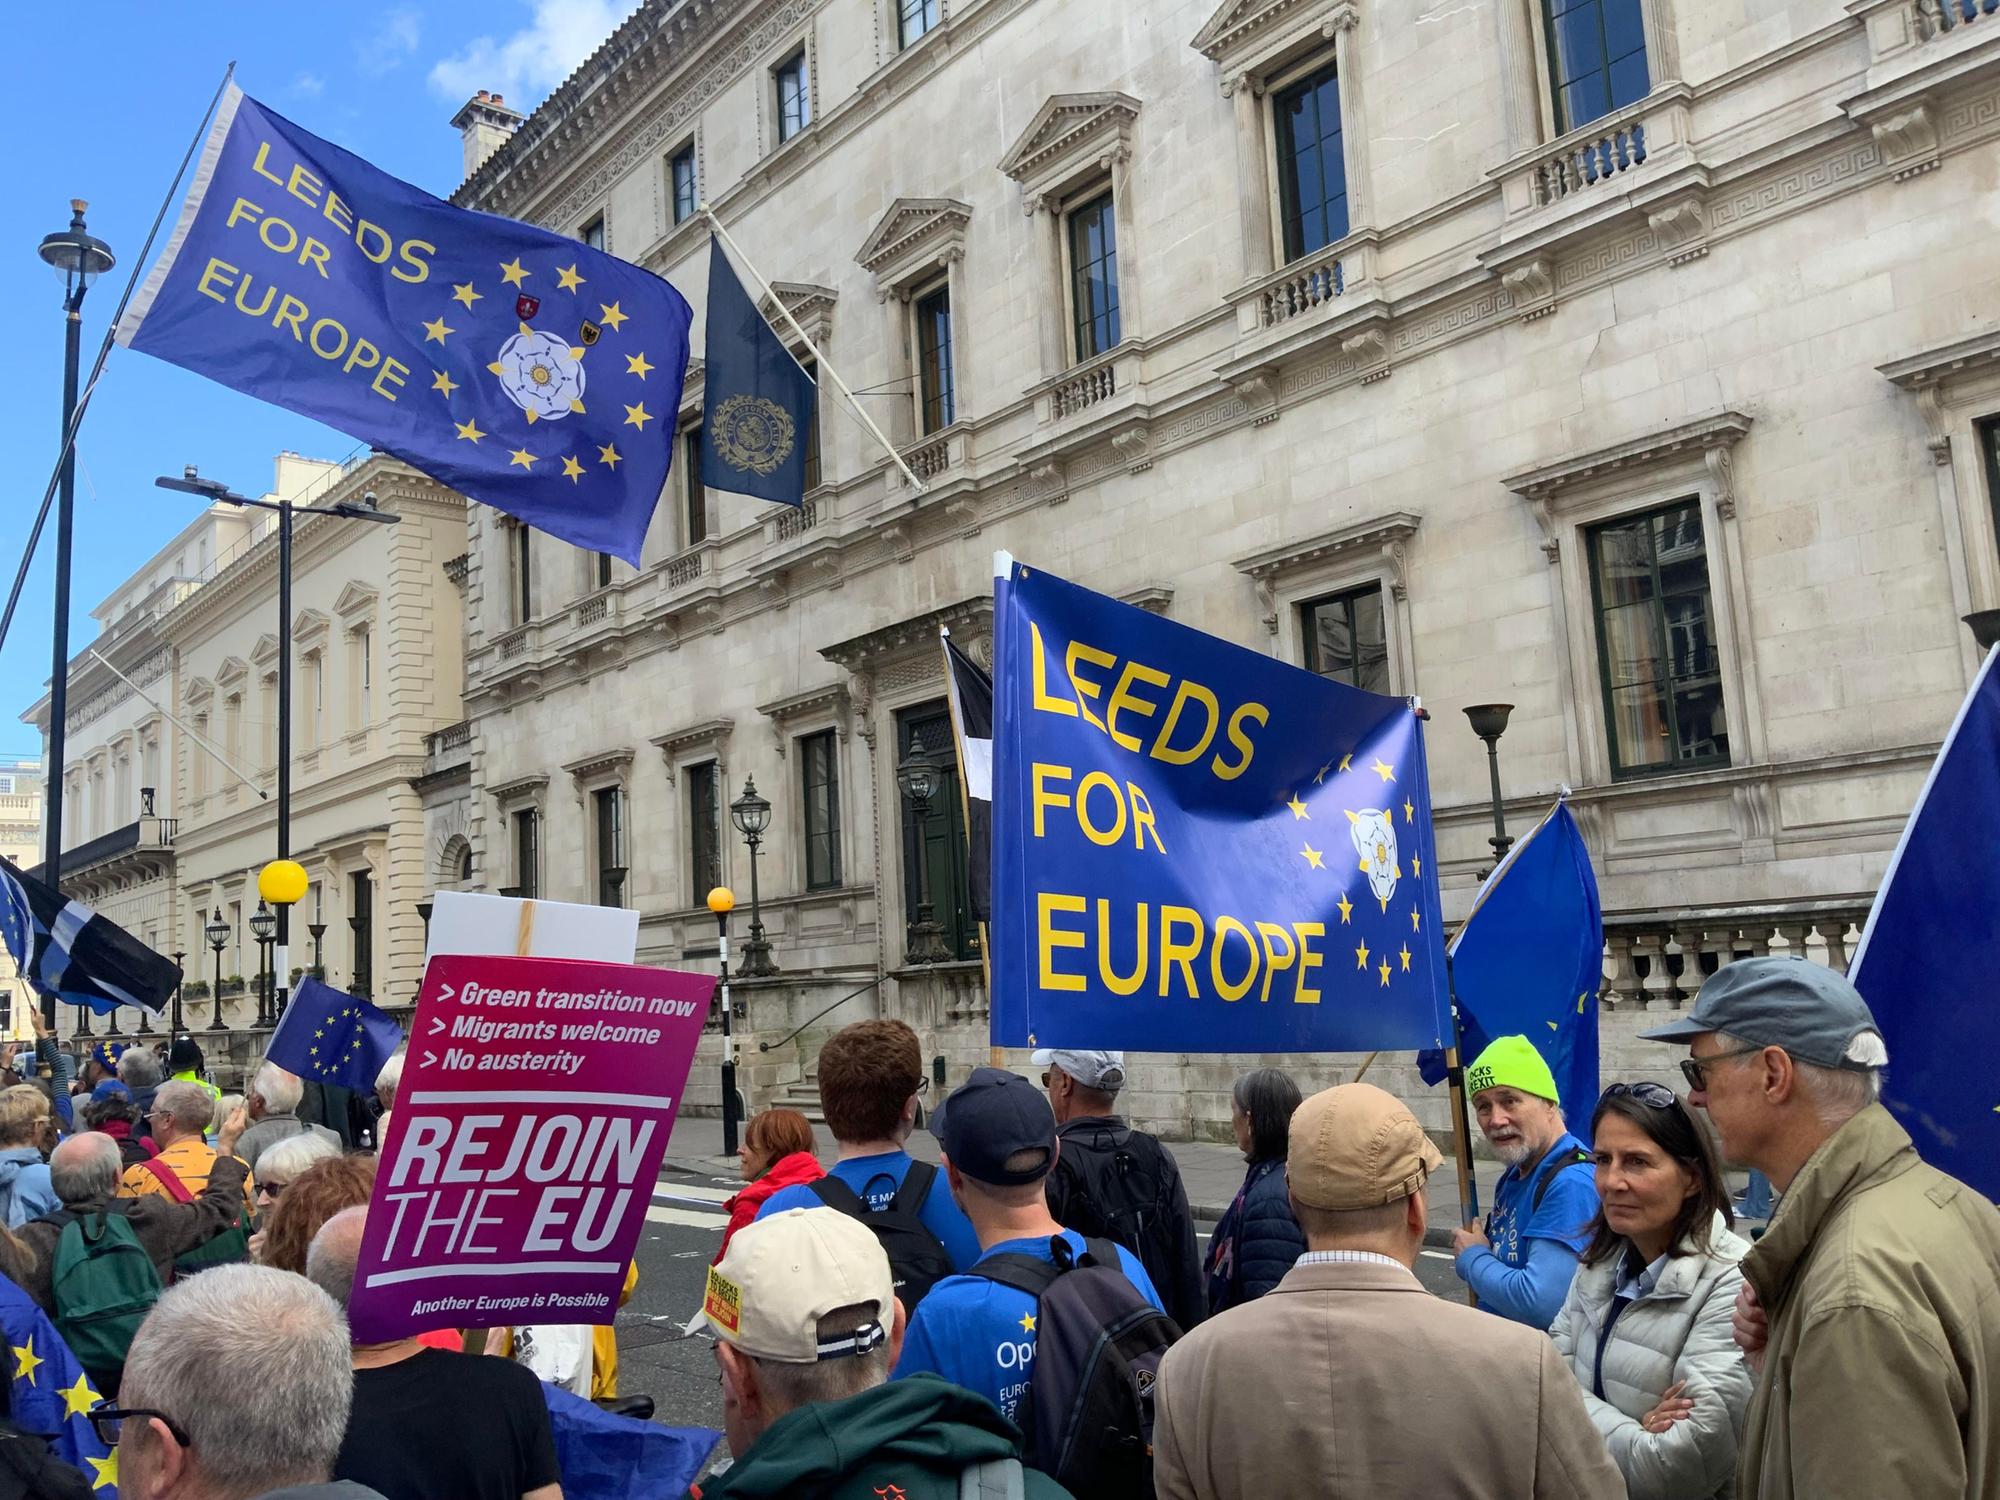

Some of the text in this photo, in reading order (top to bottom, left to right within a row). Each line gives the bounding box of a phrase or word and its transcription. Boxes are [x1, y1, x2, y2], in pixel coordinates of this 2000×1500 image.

[226, 197, 331, 279] FOR
[252, 141, 436, 283] LEEDS
[197, 257, 411, 402] EUROPE
[1030, 620, 1270, 781] LEEDS
[1031, 762, 1166, 855] FOR
[1037, 893, 1326, 1004] EUROPE
[450, 1015, 661, 1044] Migrants welcome
[460, 981, 697, 1017] Green transition now
[441, 1048, 586, 1075] No austerity
[1468, 1076, 1495, 1096] REXIT
[388, 1114, 657, 1187] REJOIN
[382, 1186, 633, 1262] THE EU
[411, 1292, 610, 1317] Another Europe is Possible
